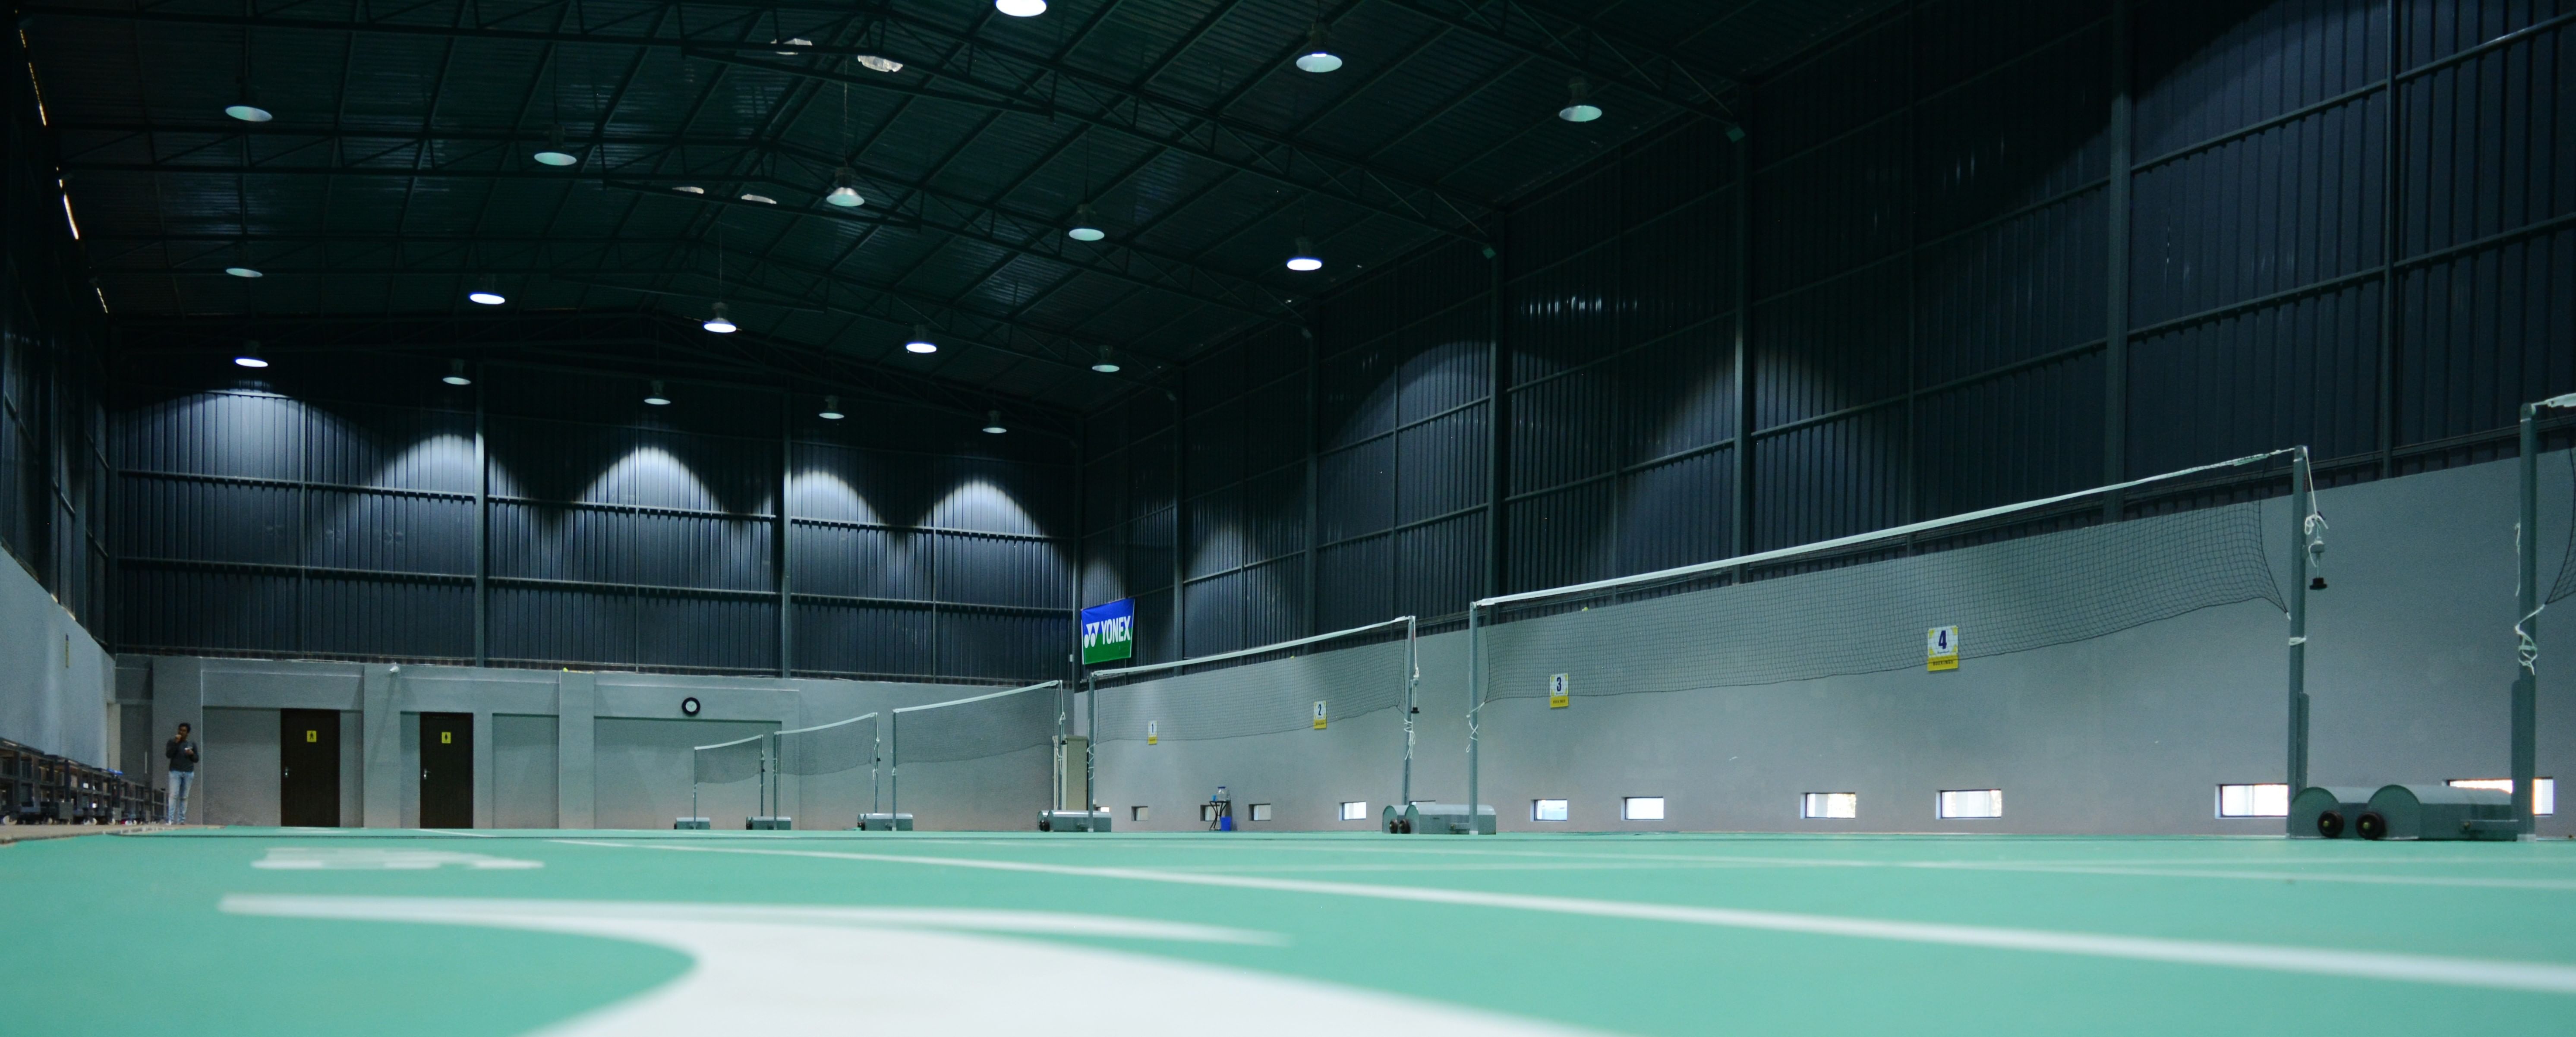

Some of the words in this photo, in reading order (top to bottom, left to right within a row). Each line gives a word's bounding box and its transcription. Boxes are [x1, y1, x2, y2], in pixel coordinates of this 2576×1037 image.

[1101, 615, 1131, 645] YONEX
[1938, 630, 1947, 649] 4
[1557, 677, 1562, 691] 3
[1318, 704, 1322, 715] 2
[1151, 723, 1154, 733] 1
